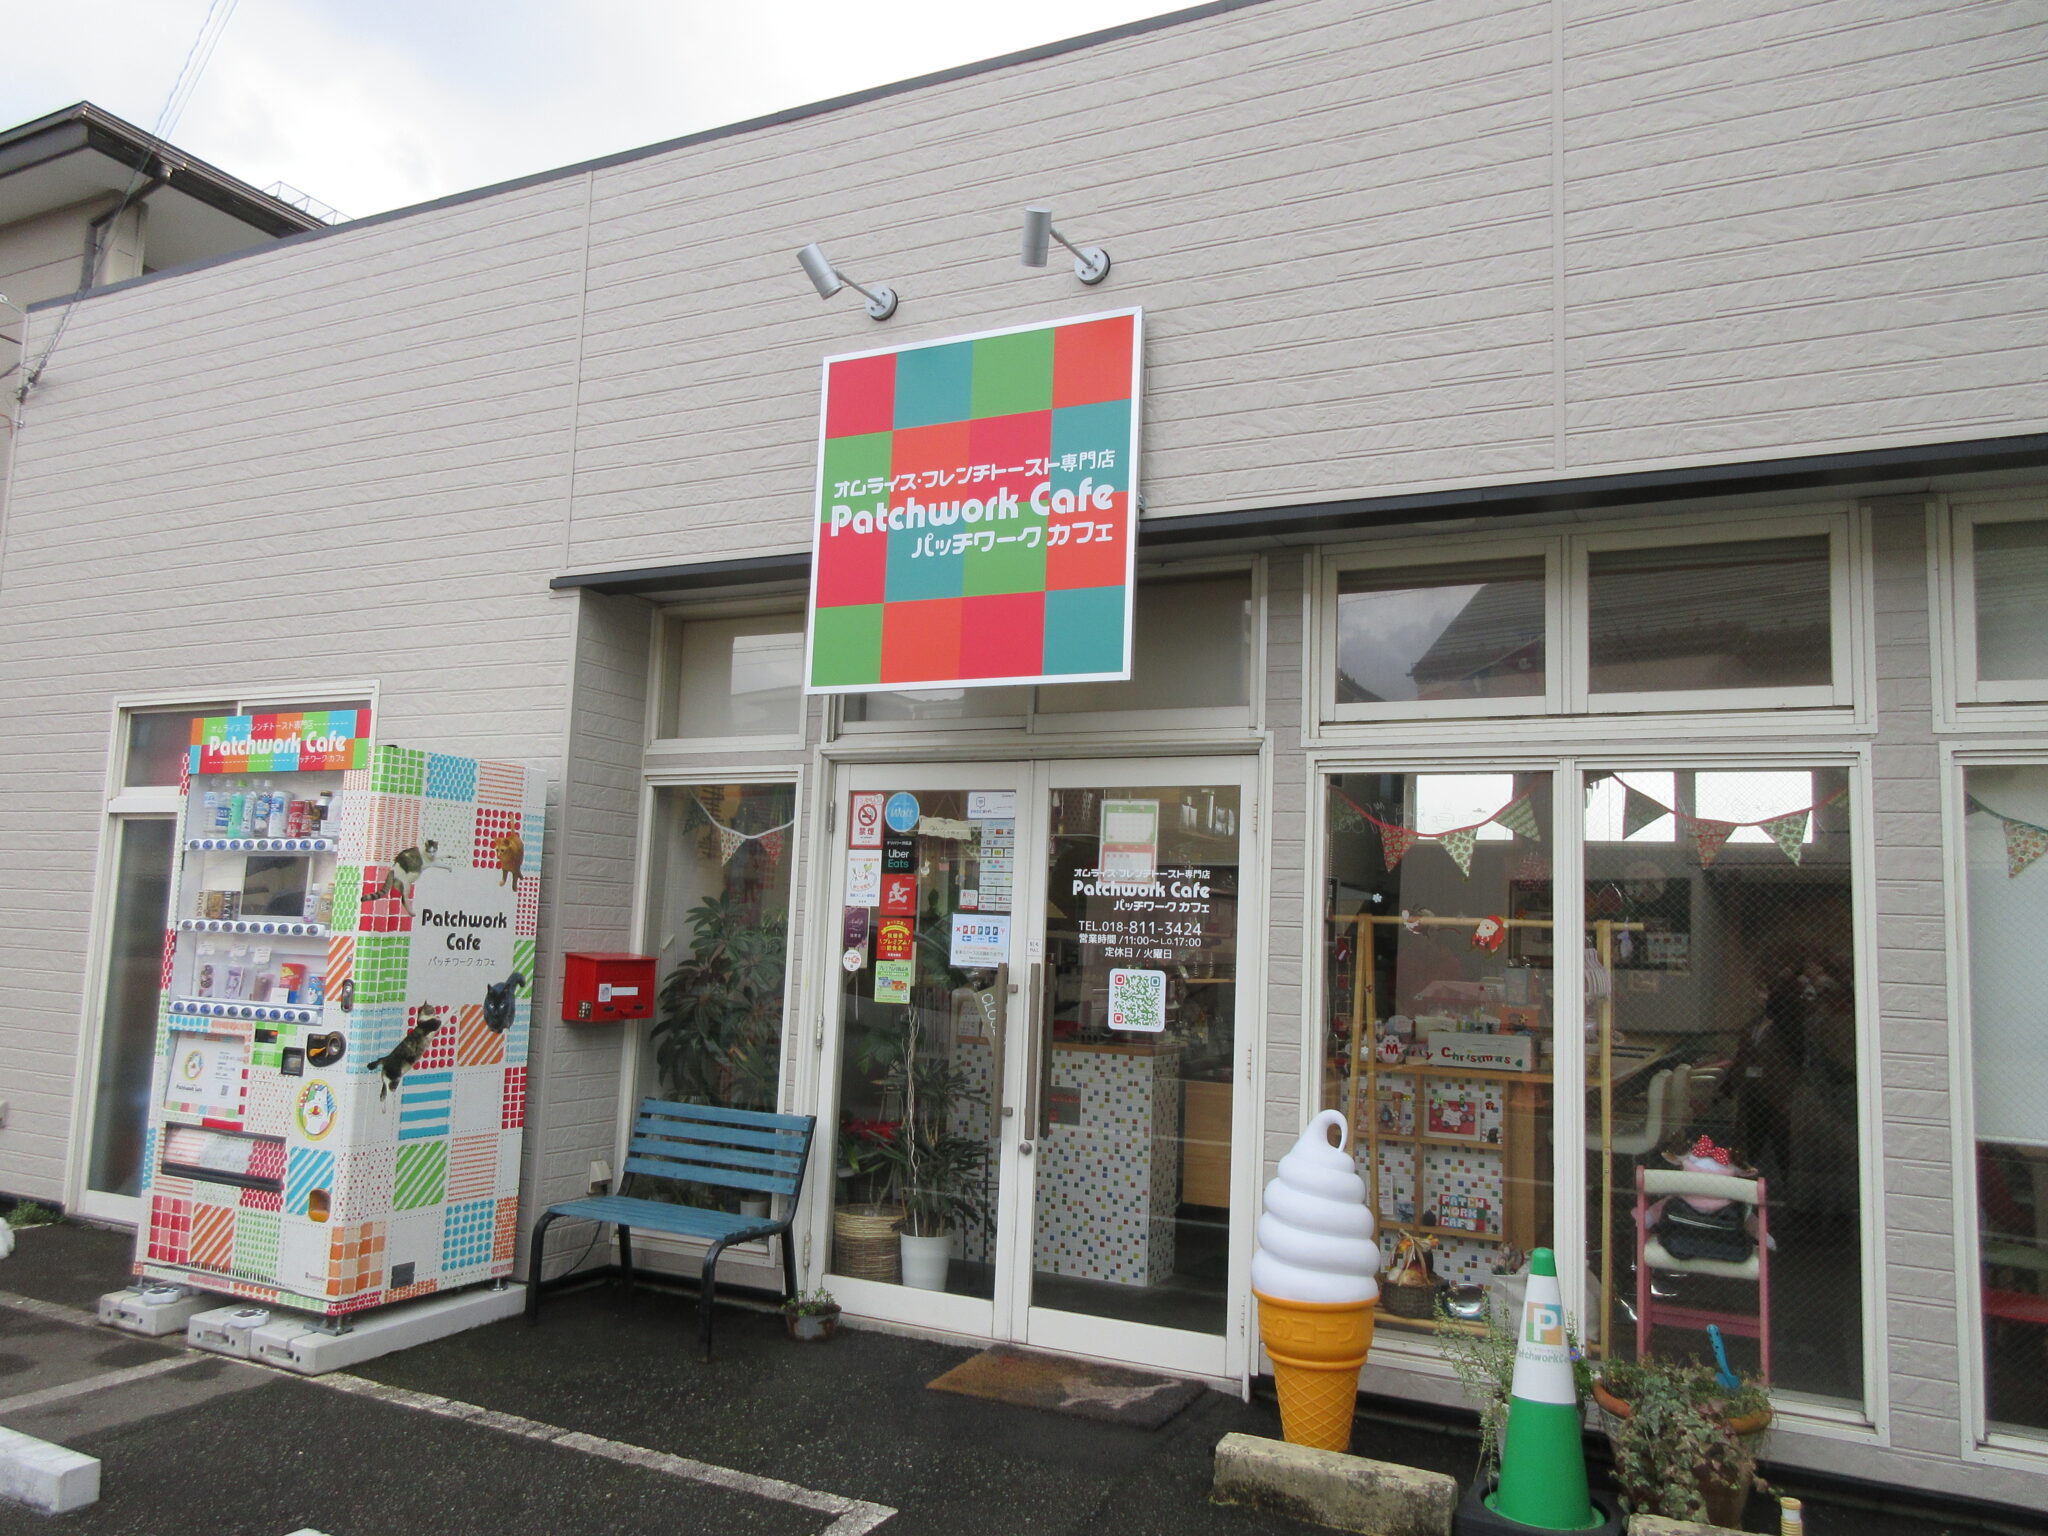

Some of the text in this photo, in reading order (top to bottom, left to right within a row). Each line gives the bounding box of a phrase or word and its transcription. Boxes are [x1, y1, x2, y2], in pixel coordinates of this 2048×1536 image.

[834, 449, 1115, 498] オムライス・フレンチトースト専門店
[830, 476, 1115, 537] Patchwork Cafe
[911, 521, 1113, 559] パッチワーク カフェ
[208, 729, 347, 757] Patchwork Cafe
[859, 827, 875, 836] 禁煙
[888, 849, 910, 858] Uber
[888, 859, 909, 868] Eats
[1073, 868, 1211, 880] オムライス・フレンチトースト専門店
[1072, 880, 1211, 899] Patchwork Cafe
[1113, 899, 1210, 913] パッチワーク カフェ
[421, 908, 508, 928] Patchwork
[1078, 920, 1203, 936] TEL.018-811-3424
[446, 932, 482, 951] Cafe
[1078, 933, 1117, 944] 営業時間
[1104, 947, 1133, 958] 定休日
[1143, 948, 1172, 959] 火曜日
[428, 956, 496, 967] パッチワーク カフェ
[1441, 1046, 1511, 1065] Christmas
[1441, 1205, 1478, 1219] WORK
[1533, 1307, 1558, 1341] P
